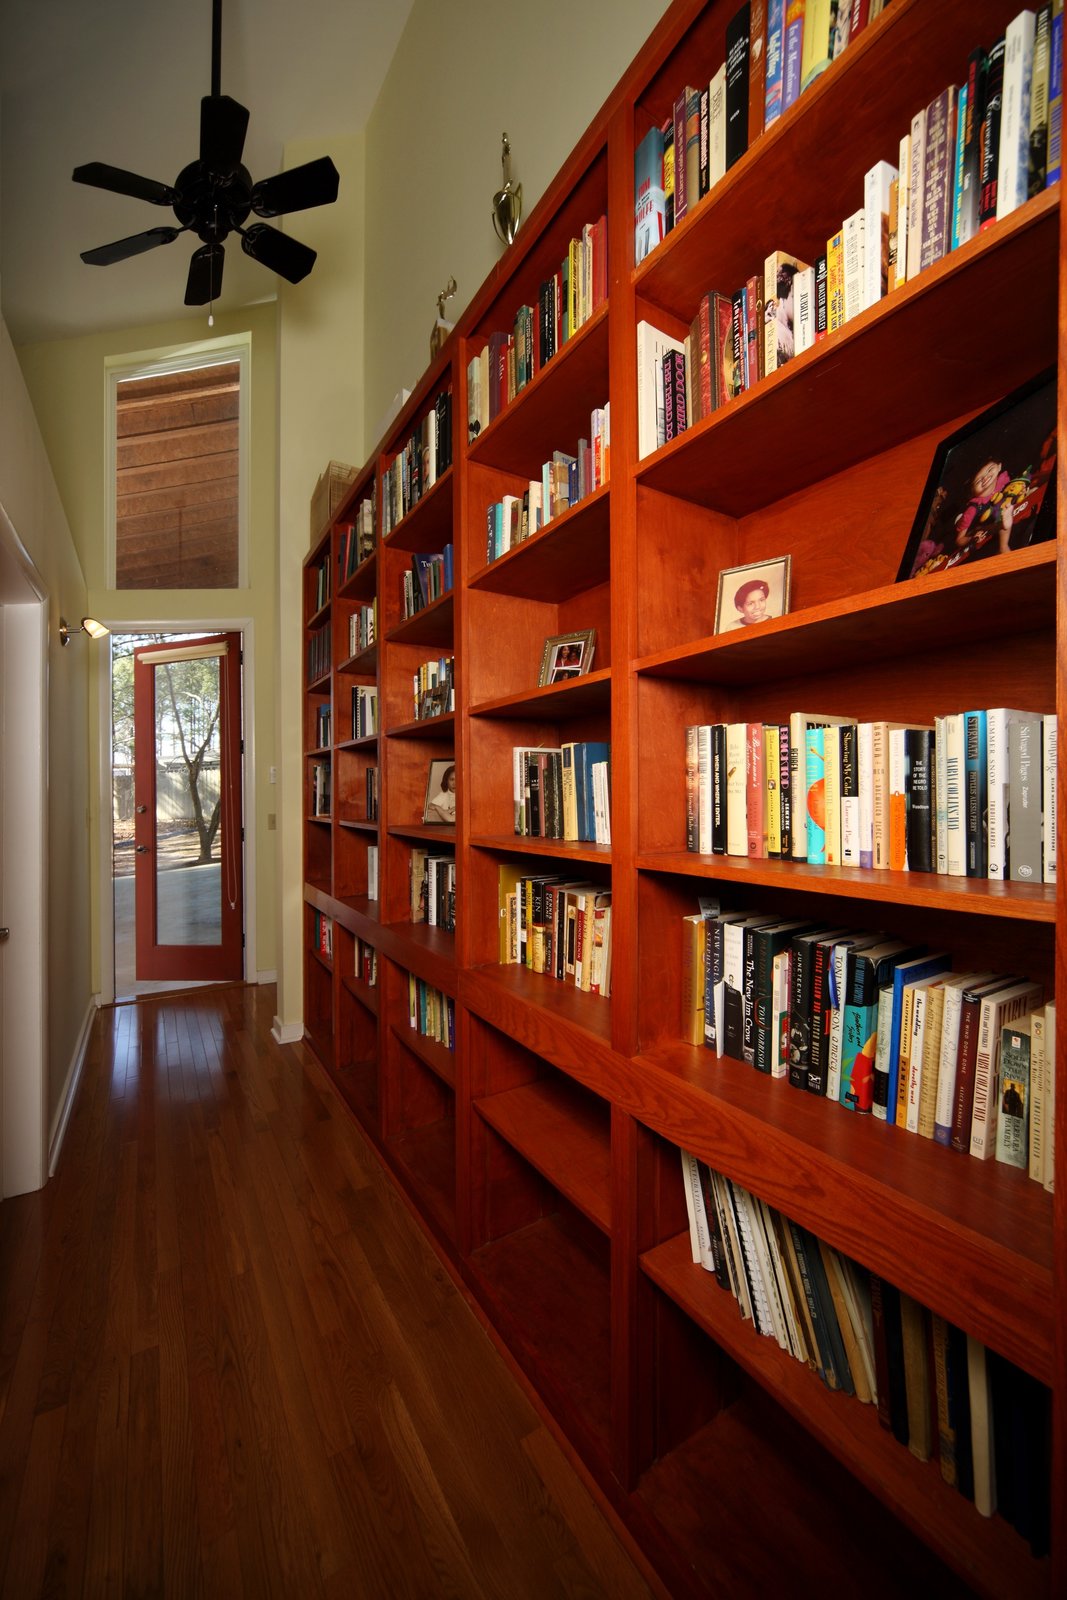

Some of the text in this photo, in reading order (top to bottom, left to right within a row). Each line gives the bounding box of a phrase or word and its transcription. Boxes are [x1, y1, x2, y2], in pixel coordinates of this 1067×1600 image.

[982, 94, 1001, 184] Conversations
[800, 292, 809, 325] JUBILEE
[818, 305, 826, 331] MOSLEY
[733, 298, 741, 358] Tempest Rising
[664, 359, 672, 384] THE
[665, 384, 673, 421] THIRD
[674, 353, 686, 436] THIRD DOOR
[780, 726, 789, 790] BRICKTOP
[843, 732, 852, 796] Showing My Color
[947, 757, 959, 782] MARVA
[1019, 726, 1031, 782] Salvaged Pages
[969, 771, 977, 832] PHYLLIS ALESIA PERRY
[947, 816, 960, 831] WAY
[815, 950, 823, 973] LITTLE
[834, 955, 843, 978] TONI
[814, 975, 823, 999] YELLOW
[758, 1005, 766, 1069] TONI MORRISON
[851, 1012, 864, 1049] Brothers and
[913, 1009, 921, 1037] wedding
[811, 1015, 821, 1065] WALTER MOSLEY
[828, 1043, 841, 1073] mercy
[976, 1051, 991, 1075] MARVA
[910, 1065, 918, 1089] dorothy
[973, 1107, 987, 1122] WAY
[1003, 1117, 1012, 1149] HAMBLY
[1012, 1117, 1021, 1152] BARBARA
[690, 1159, 702, 1214] INTEGRATION
